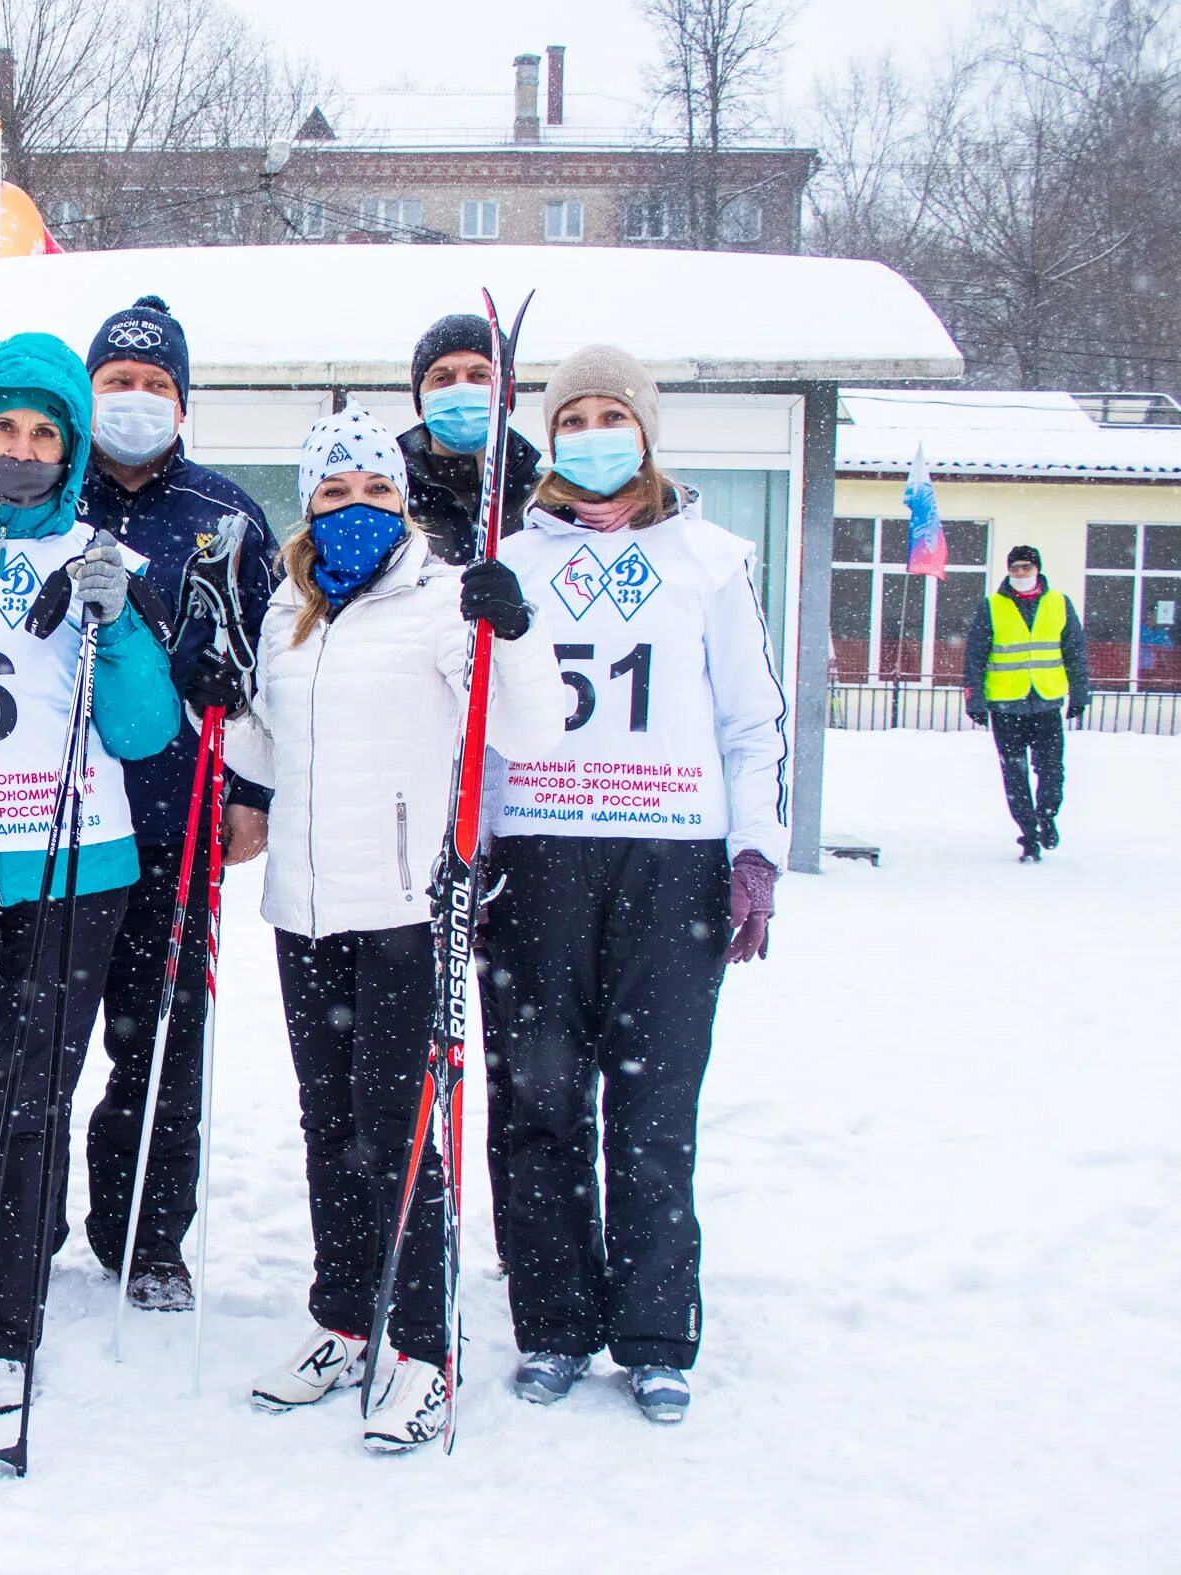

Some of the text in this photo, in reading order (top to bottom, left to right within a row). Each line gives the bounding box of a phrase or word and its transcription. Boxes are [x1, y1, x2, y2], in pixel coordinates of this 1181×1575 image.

[111, 320, 163, 334] SOCHI 2014
[2, 596, 28, 612] 33
[617, 589, 642, 604] 33
[553, 643, 652, 732] 51
[583, 761, 671, 777] СПОРТИВНЫЙ
[677, 766, 703, 777] КЛУБ
[508, 775, 699, 793] ФИНАНСОВО-ЭКОНОМИЧЕСКИХ
[534, 792, 661, 808] ОРГАНОВ РОССИИ
[88, 814, 101, 827] 33
[503, 805, 701, 825] ОРГАНИЗАЦИЯ «ДИНАМО» № 33
[450, 876, 470, 1039] ROSSIGNOL
[298, 1339, 344, 1377] R
